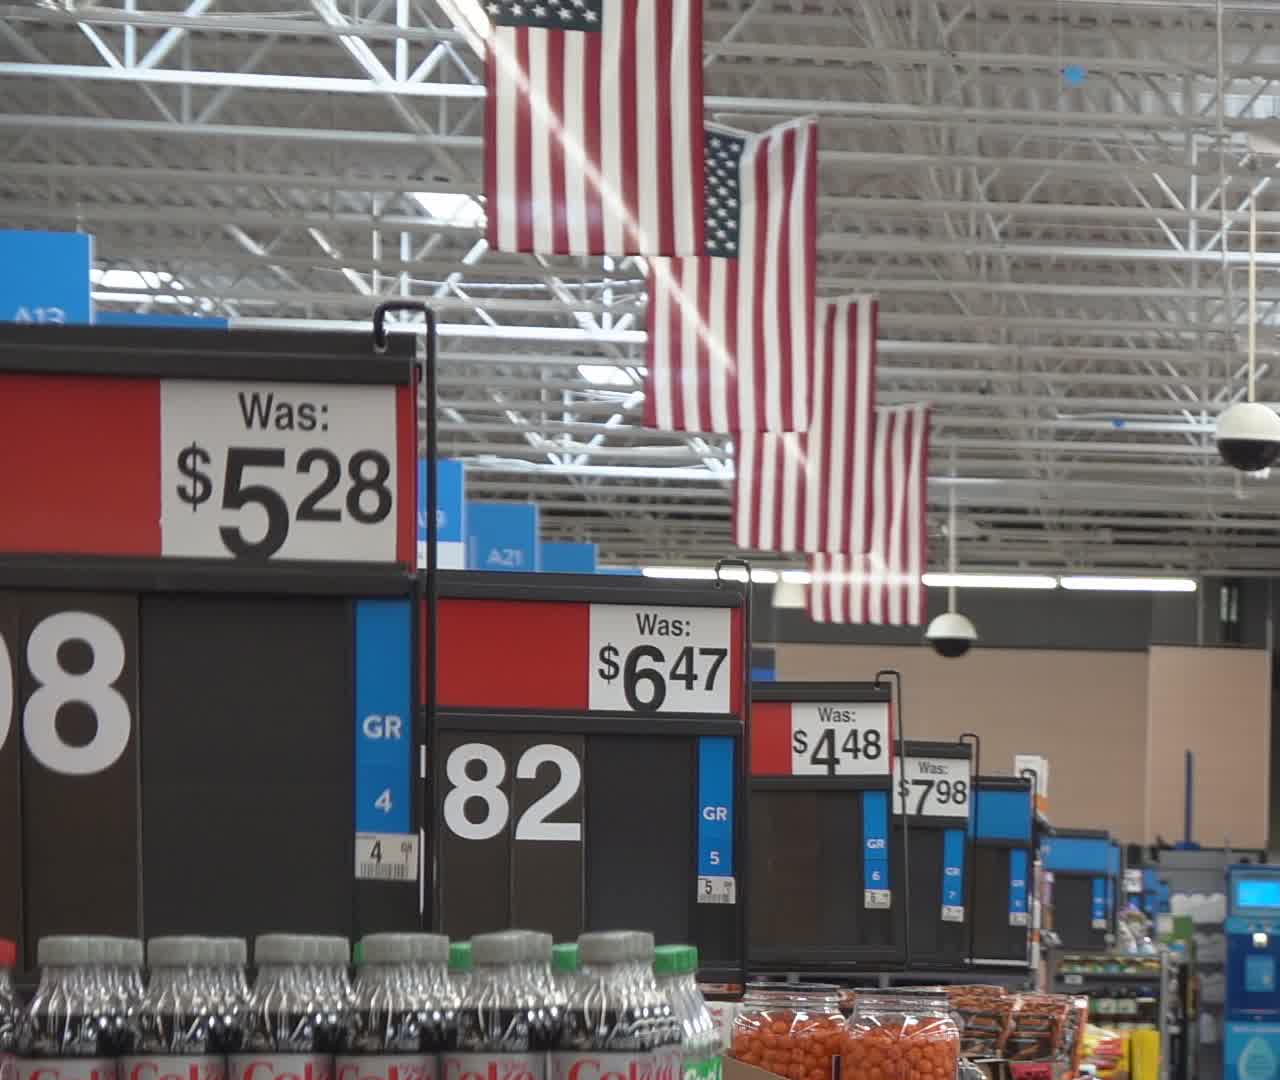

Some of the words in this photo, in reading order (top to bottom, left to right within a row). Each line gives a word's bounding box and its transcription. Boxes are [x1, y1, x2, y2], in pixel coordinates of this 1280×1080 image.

[240, 393, 329, 431] Was:
[636, 612, 691, 638] Was:
[598, 644, 728, 712] $647
[0, 610, 131, 774] 8
[817, 706, 857, 723] Was:
[362, 715, 402, 740] GR
[791, 728, 882, 775] $448
[918, 761, 949, 775] Was:
[374, 787, 393, 815] 4
[702, 806, 728, 821] GR
[370, 840, 383, 864] 4
[709, 851, 721, 865] 5
